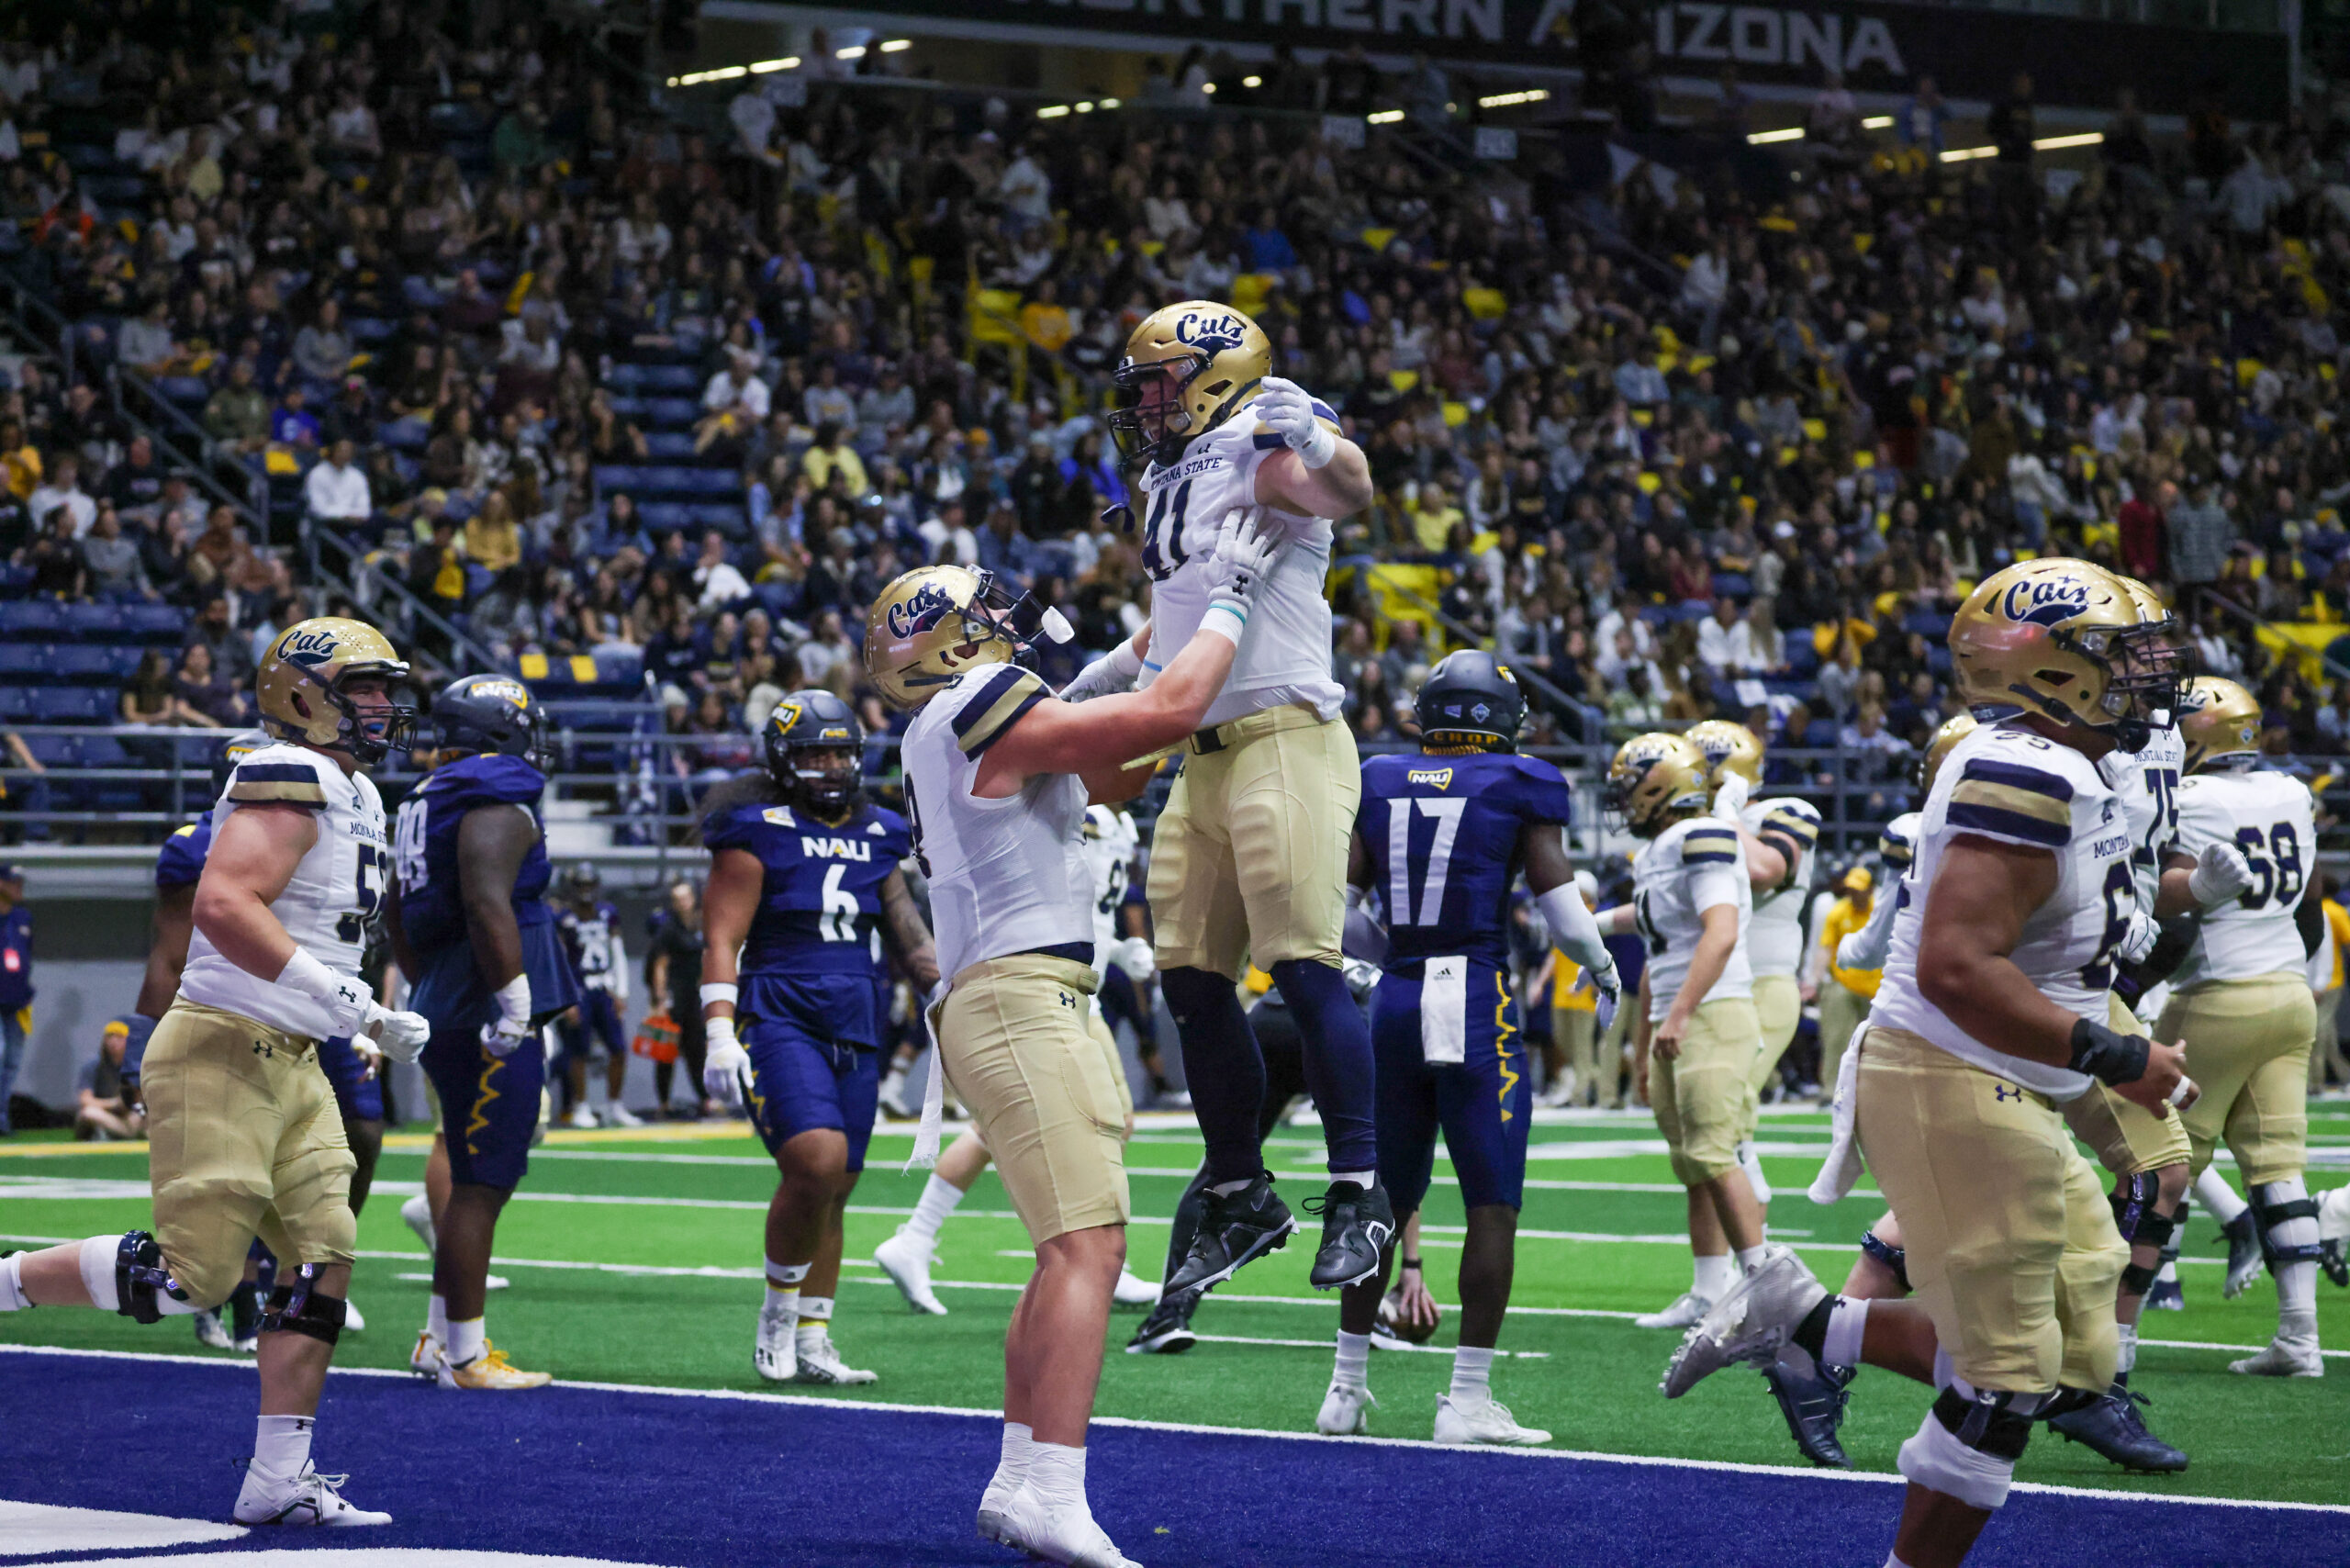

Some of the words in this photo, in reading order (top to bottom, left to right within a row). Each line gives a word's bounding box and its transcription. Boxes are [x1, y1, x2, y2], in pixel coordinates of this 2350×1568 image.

[1047, 0, 1506, 43] HERN
[1528, 0, 1907, 76] AIZONA
[1185, 457, 1223, 476] STATE
[1141, 478, 1192, 582] 41
[2005, 576, 2092, 622] Cats
[277, 630, 340, 663] Cats
[1434, 732, 1498, 745] CHOP
[1412, 773, 1449, 783] NAU
[801, 836, 871, 862] NAU
[2134, 768, 2180, 867] 75
[1387, 797, 1468, 926] 17
[2235, 821, 2303, 911] 68
[819, 863, 860, 943] 6
[2080, 856, 2138, 991] 6
